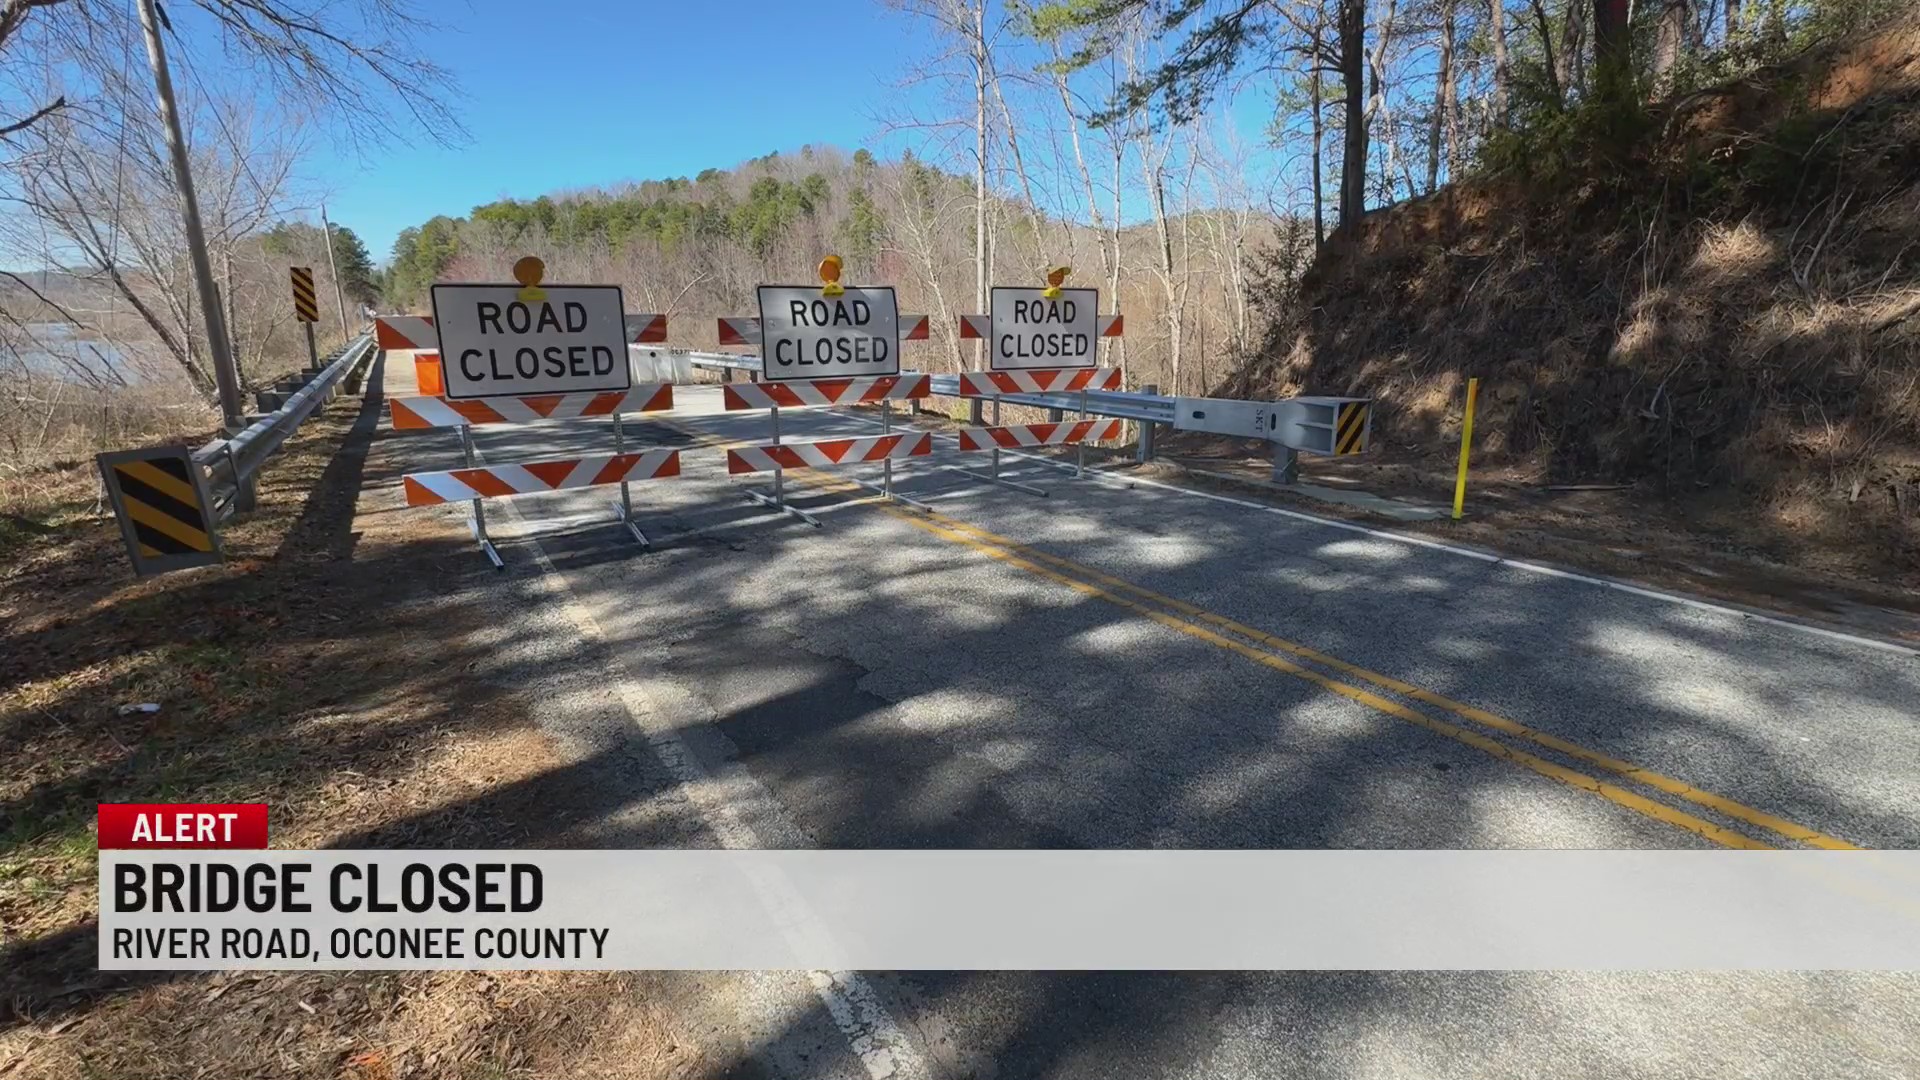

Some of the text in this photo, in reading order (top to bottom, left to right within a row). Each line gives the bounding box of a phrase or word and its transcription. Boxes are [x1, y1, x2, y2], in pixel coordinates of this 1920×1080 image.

[477, 301, 587, 334] ROAD
[791, 300, 871, 327] ROAD
[1014, 300, 1076, 323] ROAD
[775, 337, 888, 366] CLOSED
[1000, 334, 1087, 358] CLOSED
[460, 346, 614, 381] CLOSED
[1255, 409, 1264, 433] SKT
